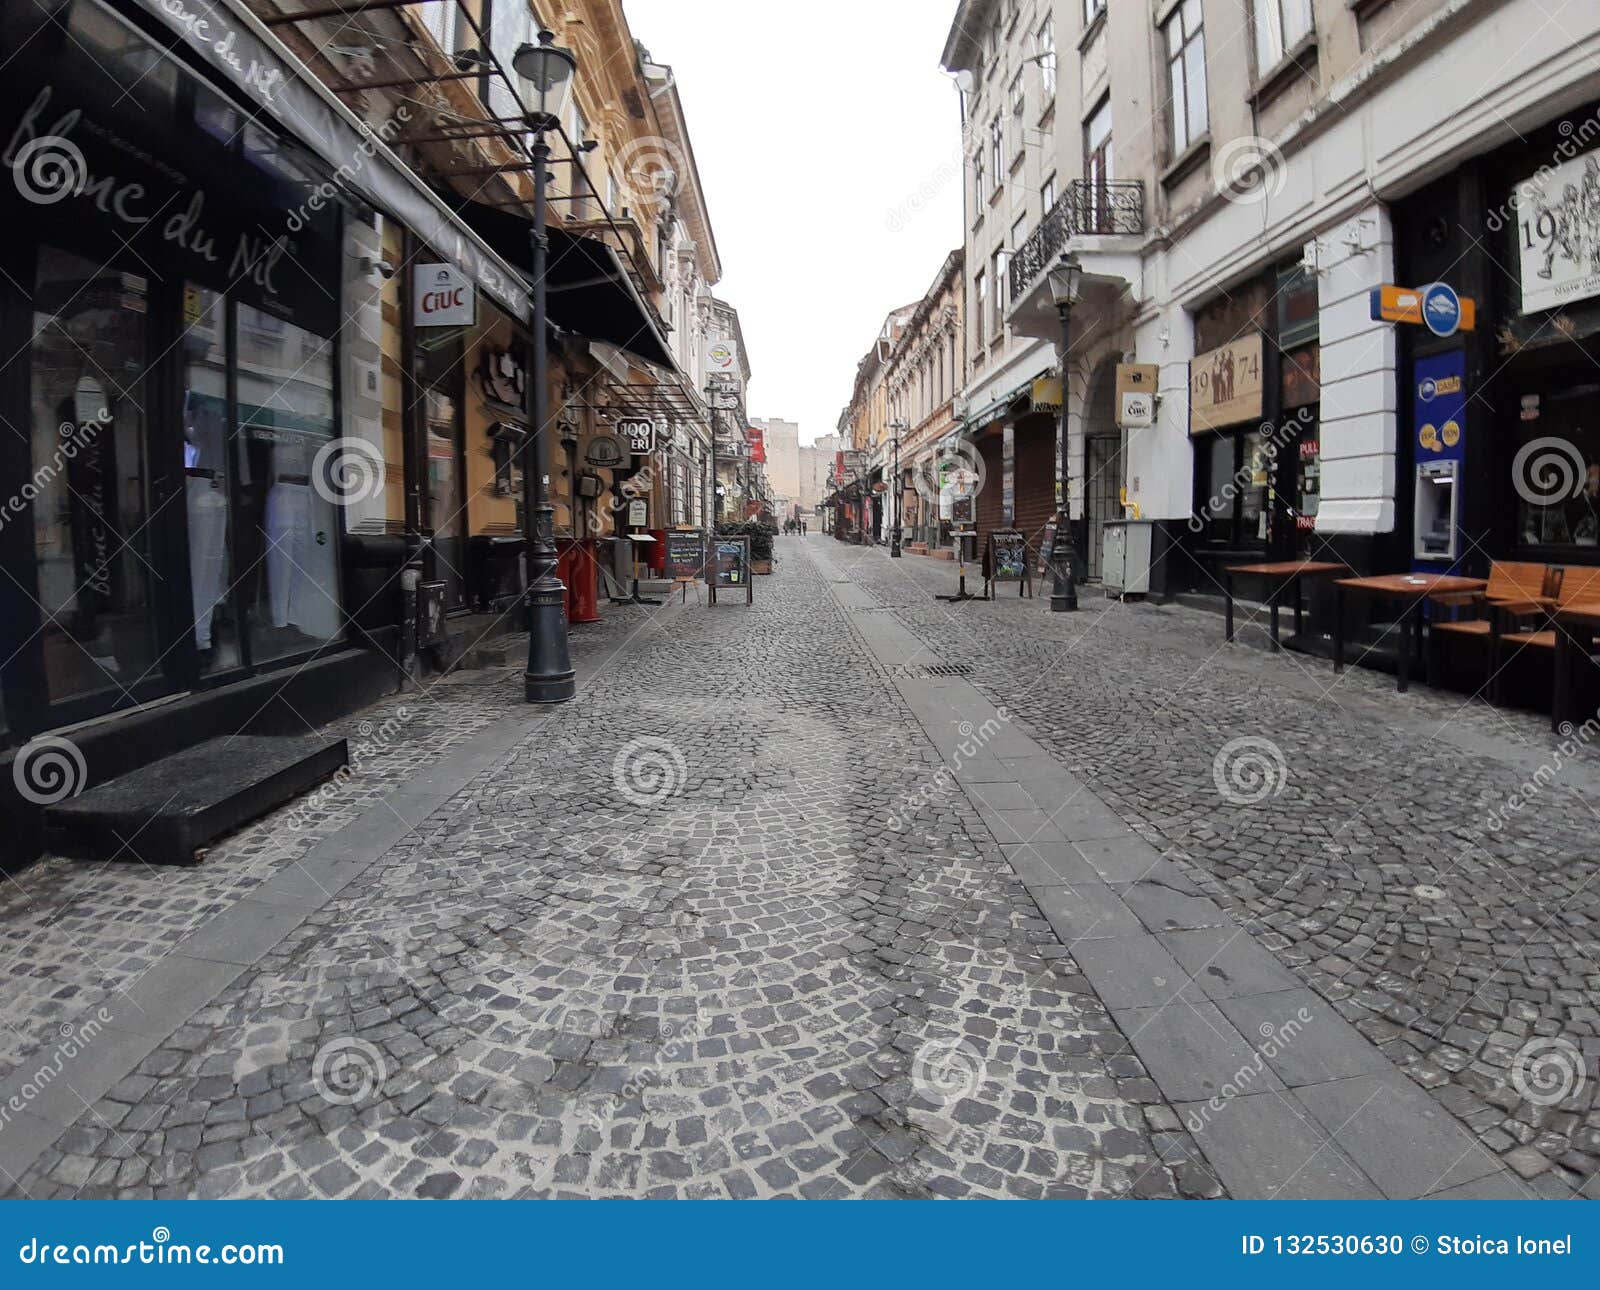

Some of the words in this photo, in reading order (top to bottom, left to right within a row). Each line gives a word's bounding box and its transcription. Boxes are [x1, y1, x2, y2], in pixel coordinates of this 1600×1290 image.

[163, 190, 219, 262] du
[228, 232, 289, 294] Nil
[1520, 210, 1557, 252] 19
[1239, 352, 1260, 386] 74
[621, 422, 650, 437] 100
[631, 438, 649, 450] ERI
[1297, 516, 1317, 529] TRAG
